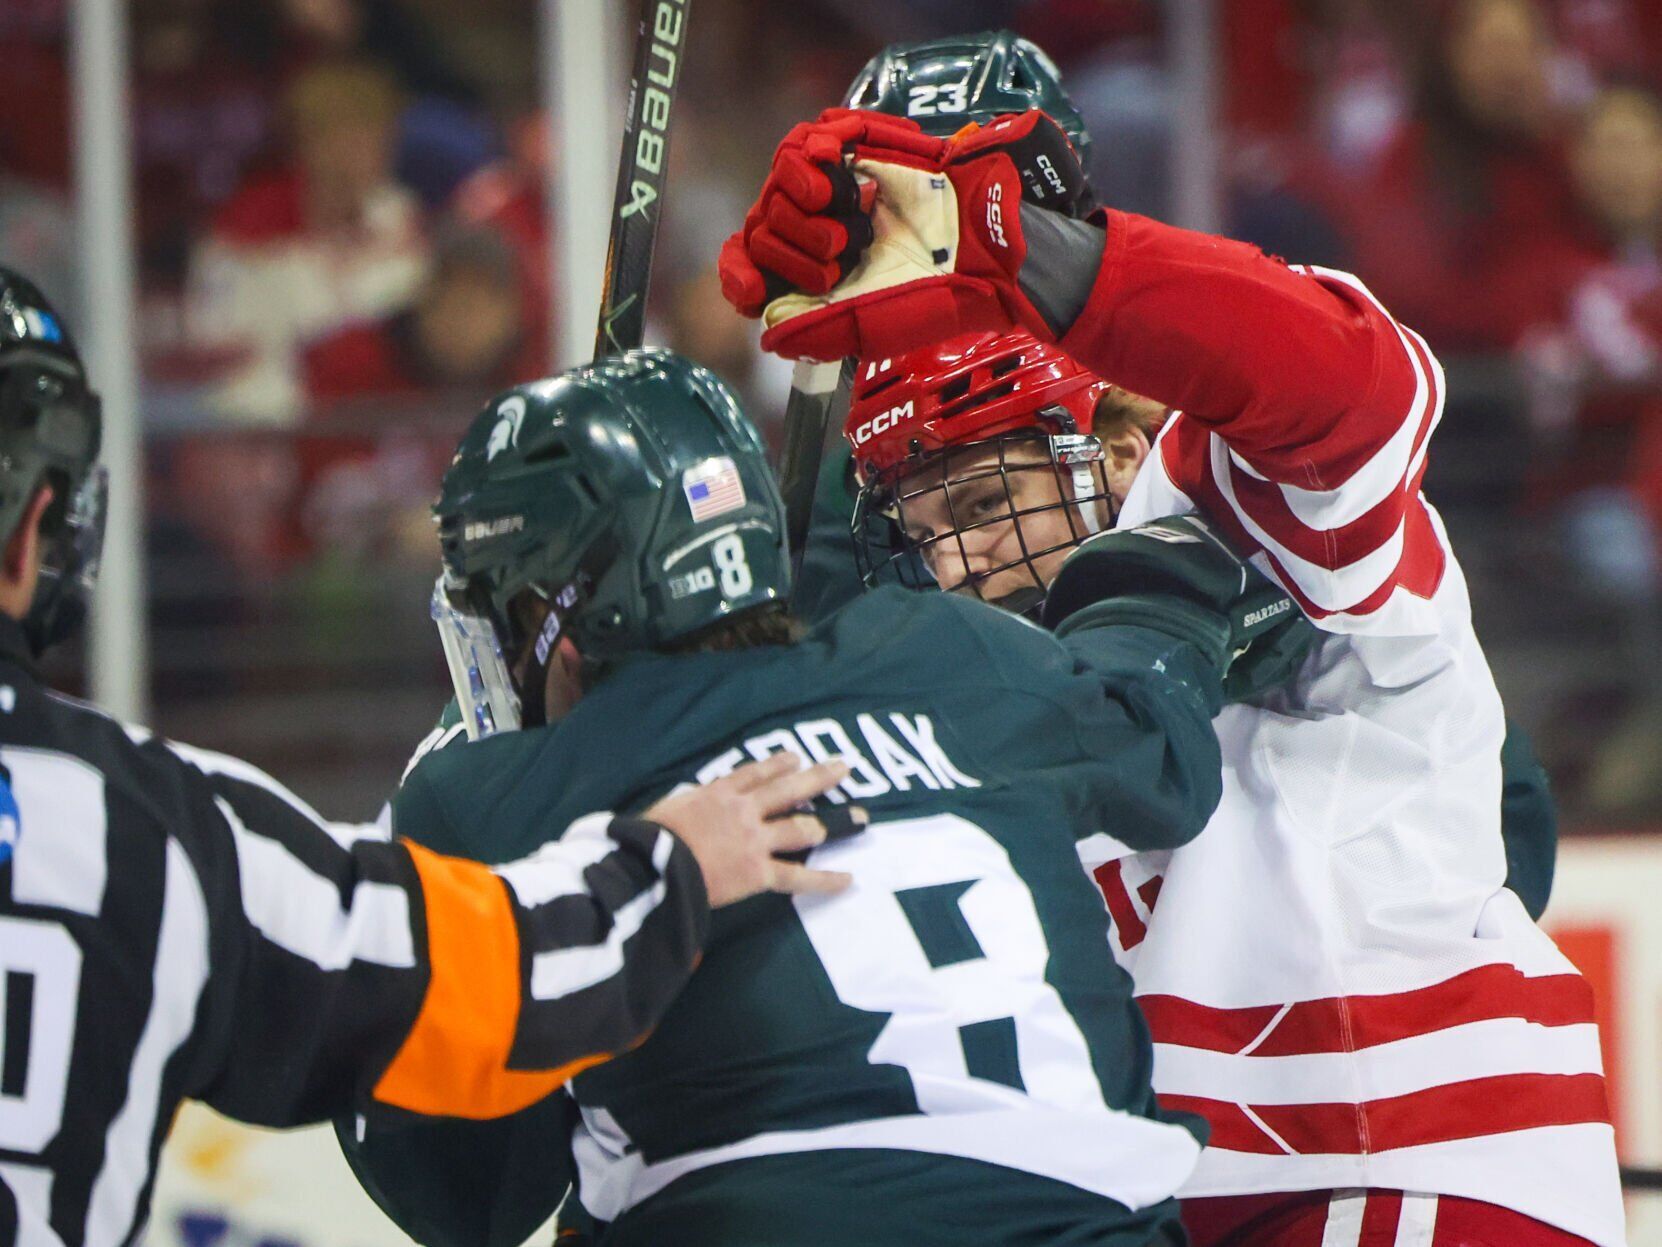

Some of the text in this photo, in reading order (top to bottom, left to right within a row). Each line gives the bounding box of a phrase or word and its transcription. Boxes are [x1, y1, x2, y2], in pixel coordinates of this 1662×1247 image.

[635, 0, 685, 176] Baue
[908, 83, 968, 117] 23
[1036, 154, 1068, 195] CCM
[990, 176, 1009, 248] CCM
[856, 400, 914, 445] CCM
[711, 531, 753, 600] 8
[791, 811, 1106, 1116] 8
